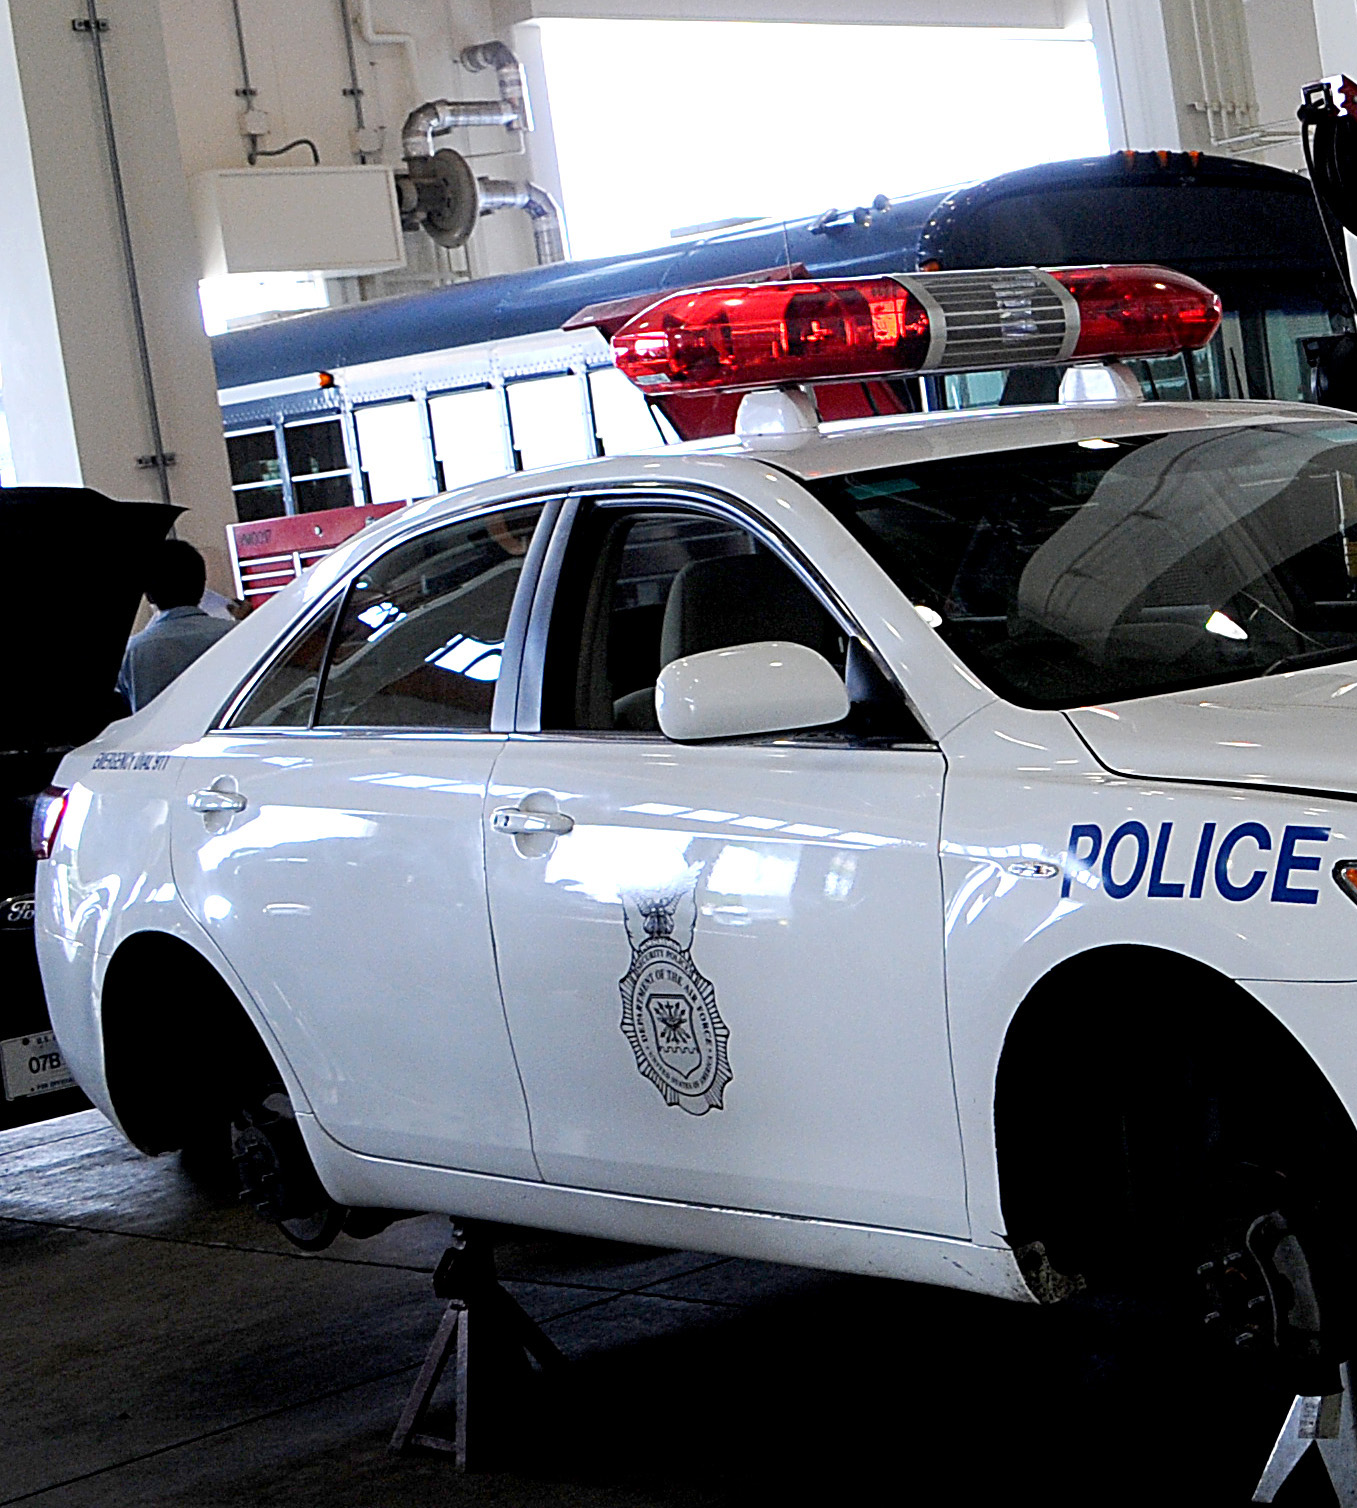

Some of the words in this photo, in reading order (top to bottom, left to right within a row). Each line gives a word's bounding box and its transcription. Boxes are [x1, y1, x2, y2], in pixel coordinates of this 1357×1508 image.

[1061, 820, 1331, 905] POLICE
[8, 900, 35, 921] Fo
[635, 972, 654, 1043] DEPARTMENT
[655, 969, 664, 980] OF
[667, 970, 683, 987] THE
[684, 984, 698, 1003] AIR
[697, 1006, 712, 1045] FORCE
